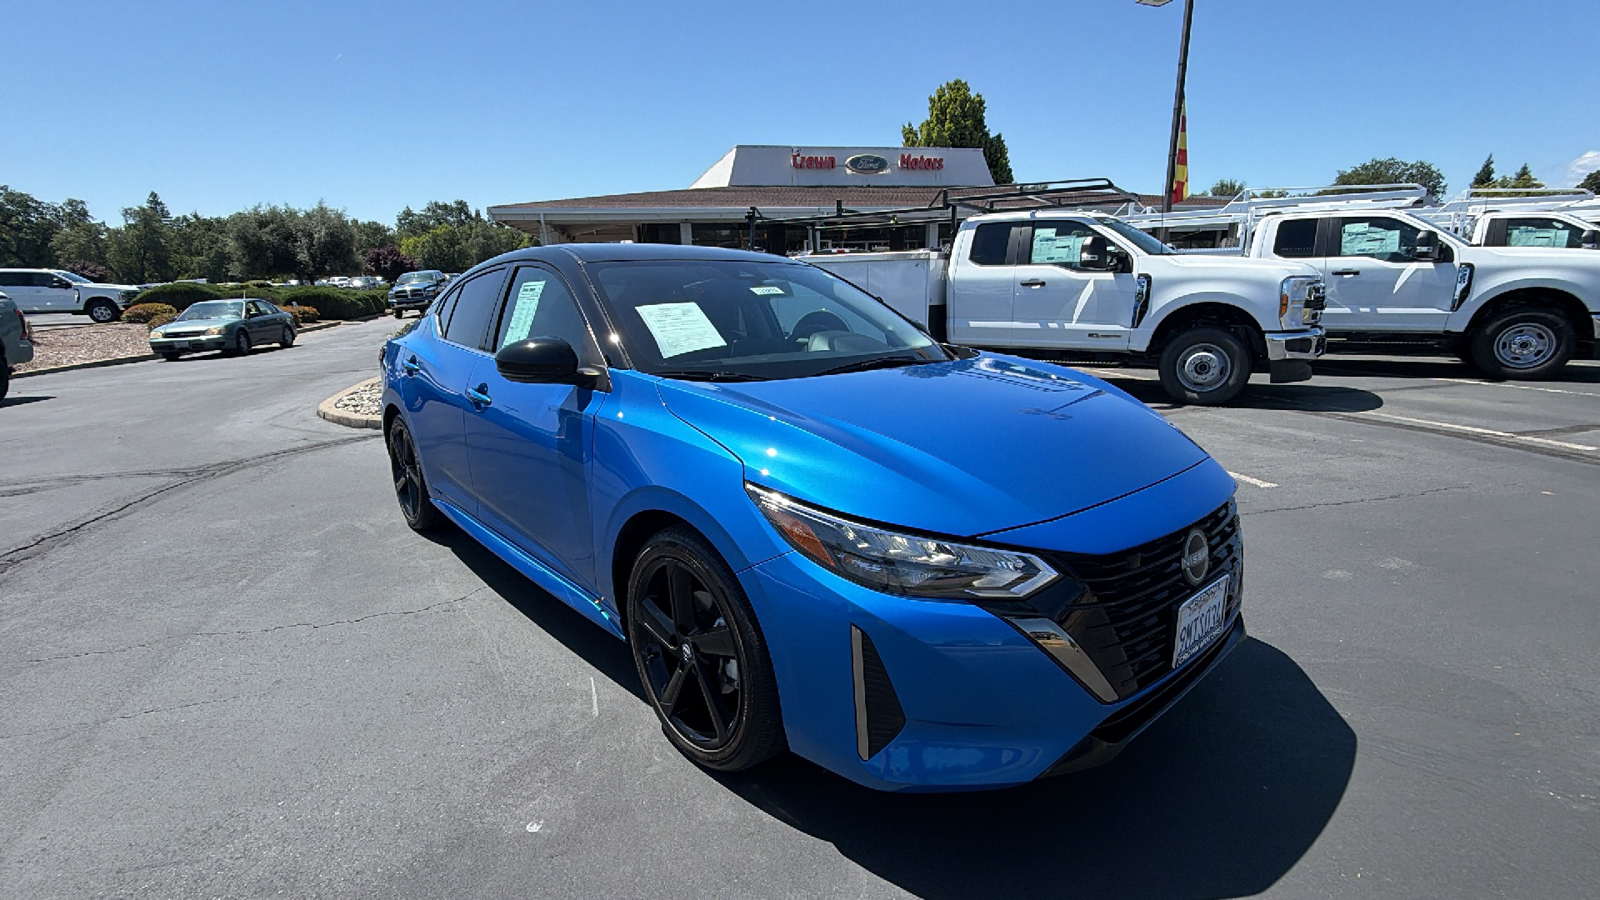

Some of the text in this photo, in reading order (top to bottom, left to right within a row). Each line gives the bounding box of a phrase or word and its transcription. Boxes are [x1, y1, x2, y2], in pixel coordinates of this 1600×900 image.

[792, 153, 836, 170] Crown
[857, 158, 881, 170] Ford
[900, 153, 944, 170] Motors
